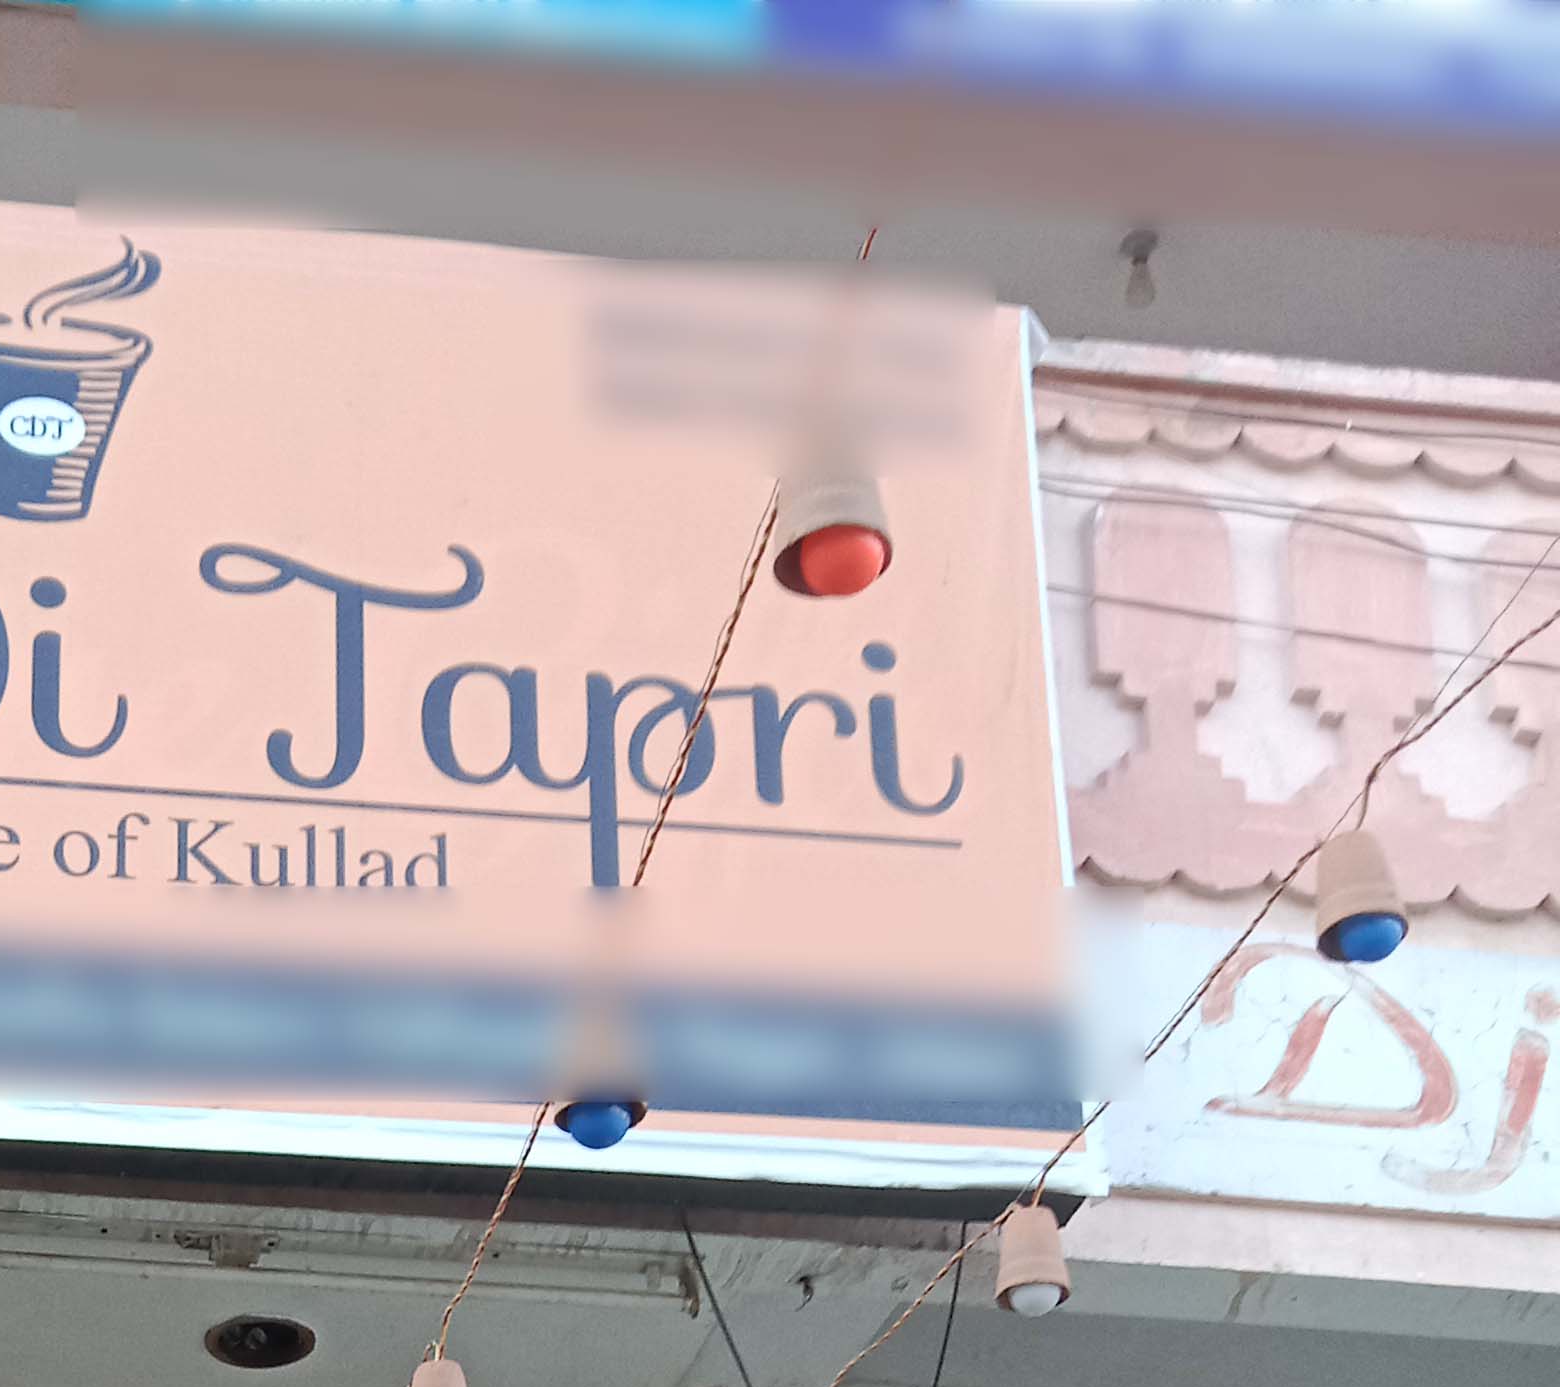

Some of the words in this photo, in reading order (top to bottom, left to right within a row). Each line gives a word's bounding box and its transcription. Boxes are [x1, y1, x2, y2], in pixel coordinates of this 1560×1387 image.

[199, 541, 964, 886] Tapri
[52, 812, 151, 880] of
[168, 816, 451, 887] Kullad
